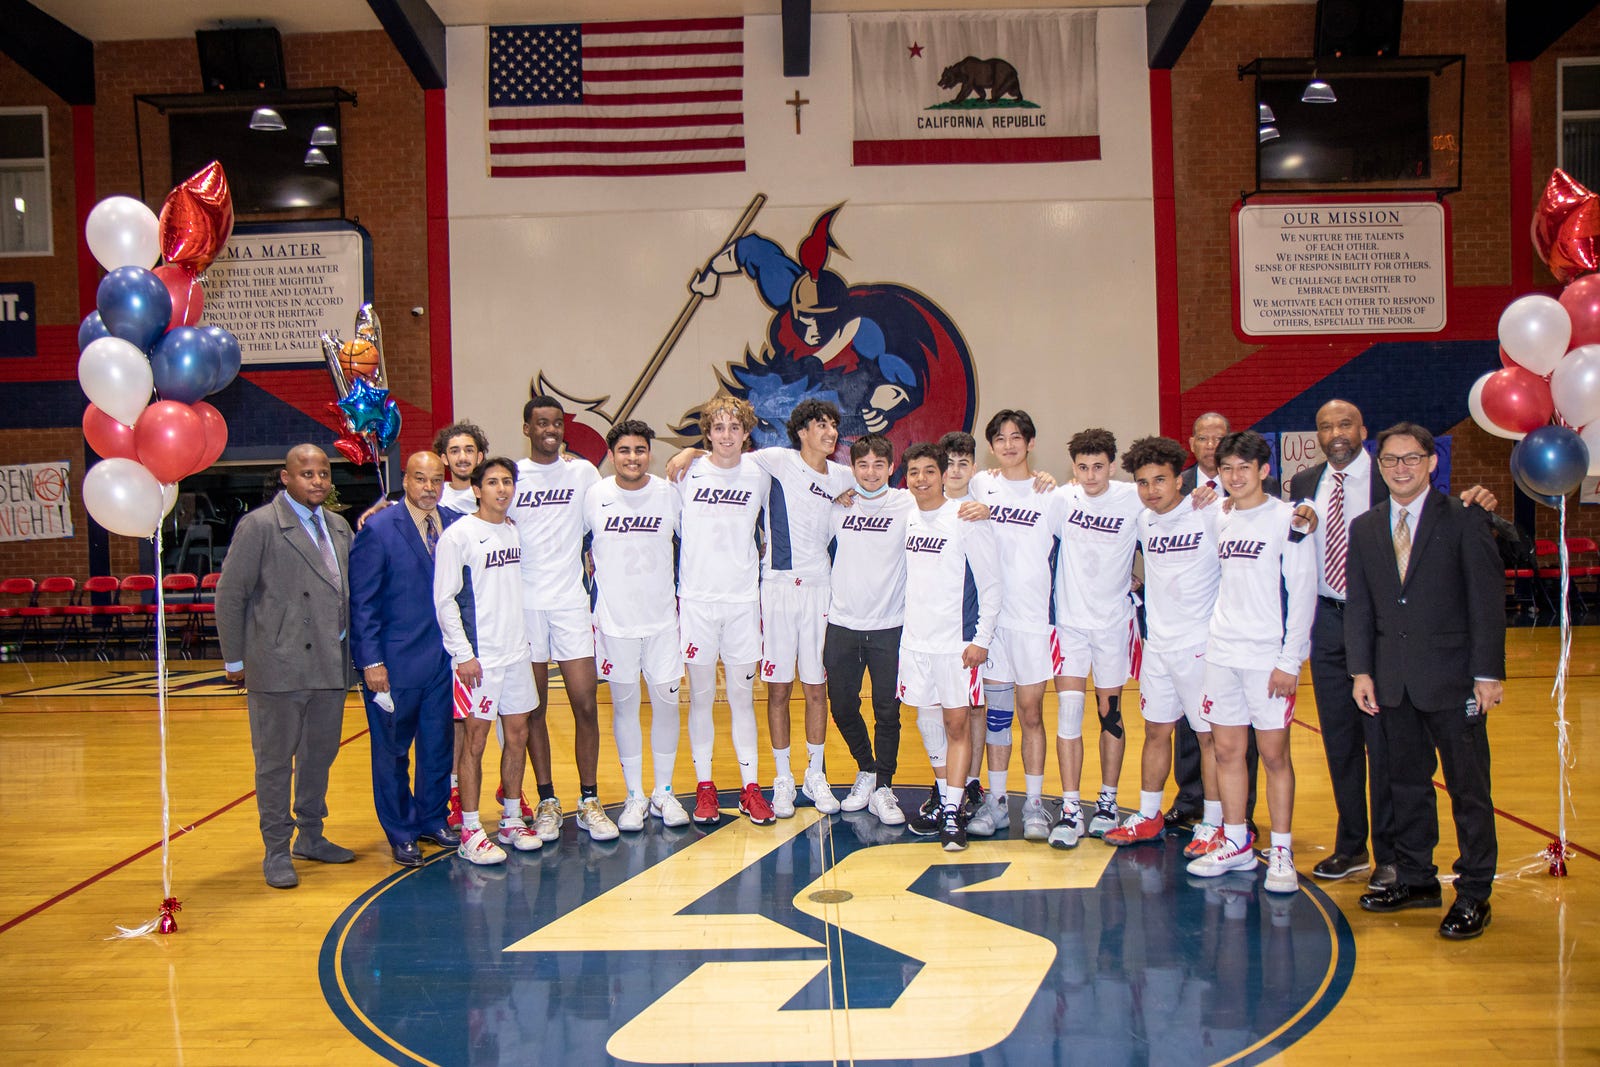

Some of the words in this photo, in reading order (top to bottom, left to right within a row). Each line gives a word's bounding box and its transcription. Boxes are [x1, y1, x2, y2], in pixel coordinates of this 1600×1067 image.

[917, 116, 984, 129] CALIFORNIA
[992, 115, 1046, 128] REPUBLIC
[1284, 212, 1320, 225] OUR
[1328, 211, 1400, 224] MISSION
[1281, 233, 1297, 242] WE
[1299, 233, 1343, 242] NURTURE
[1345, 233, 1363, 241] THE
[1365, 232, 1405, 241] TALENTS
[218, 246, 253, 259] MA
[262, 243, 322, 257] MATER
[1305, 243, 1318, 252] OF
[1321, 243, 1344, 252] EACH
[1276, 253, 1292, 262] WE
[1294, 253, 1329, 261] INSPIRE
[1332, 253, 1342, 261] IN
[1345, 252, 1368, 261] EACH
[1371, 252, 1401, 260] OTHER
[1404, 252, 1410, 260] A
[212, 269, 225, 277] TO
[227, 268, 251, 277] THEE
[254, 267, 275, 276] OUR
[277, 266, 304, 275] ALMA
[307, 264, 339, 274] MATER
[1255, 264, 1283, 272] SENSE
[1285, 263, 1297, 272] OF
[1300, 262, 1371, 271] RESPONSIBILITY
[1374, 262, 1391, 270] FOR
[220, 279, 250, 288] EXTOL
[253, 278, 276, 287] THEE
[279, 276, 325, 287] MIGHTILY
[1271, 276, 1287, 285] WE
[1289, 276, 1343, 285] CHALLENGE
[1345, 276, 1368, 284] EACH
[1371, 275, 1401, 284] OTHER
[1403, 275, 1416, 283] TO
[228, 290, 241, 298] TO
[245, 289, 268, 298] THEE
[271, 288, 291, 297] AND
[294, 286, 334, 296] LOYALTY
[1298, 286, 1340, 295] EMBRACE
[227, 301, 252, 310] WITH
[255, 299, 288, 309] VOICES
[291, 299, 301, 307] IN
[305, 297, 344, 306] ACCORD
[1253, 299, 1268, 308] WE
[1271, 299, 1317, 308] MOTIVATE
[1319, 298, 1343, 307] EACH
[1345, 298, 1376, 306] OTHER
[1379, 297, 1390, 305] TO
[1393, 296, 1435, 305] RESPOND
[203, 312, 237, 321] PROUD
[239, 311, 252, 320] OF
[254, 310, 275, 319] OUR
[278, 308, 324, 318] HERITAGE
[1260, 308, 1344, 318] COMPASSIONATELY
[1347, 308, 1360, 316] TO
[1361, 308, 1380, 316] THE
[1382, 307, 1412, 315] NEEDS
[1414, 306, 1426, 315] OF
[246, 322, 258, 330] OF
[261, 321, 275, 330] ITS
[278, 320, 318, 329] DIGNITY
[1314, 317, 1365, 327] ESPECIALLY
[1368, 317, 1385, 325] THE
[258, 331, 279, 340] AND
[249, 343, 272, 352] THEE
[275, 341, 288, 351] LA
[290, 341, 318, 350] SALLE
[763, 660, 776, 677] LS
